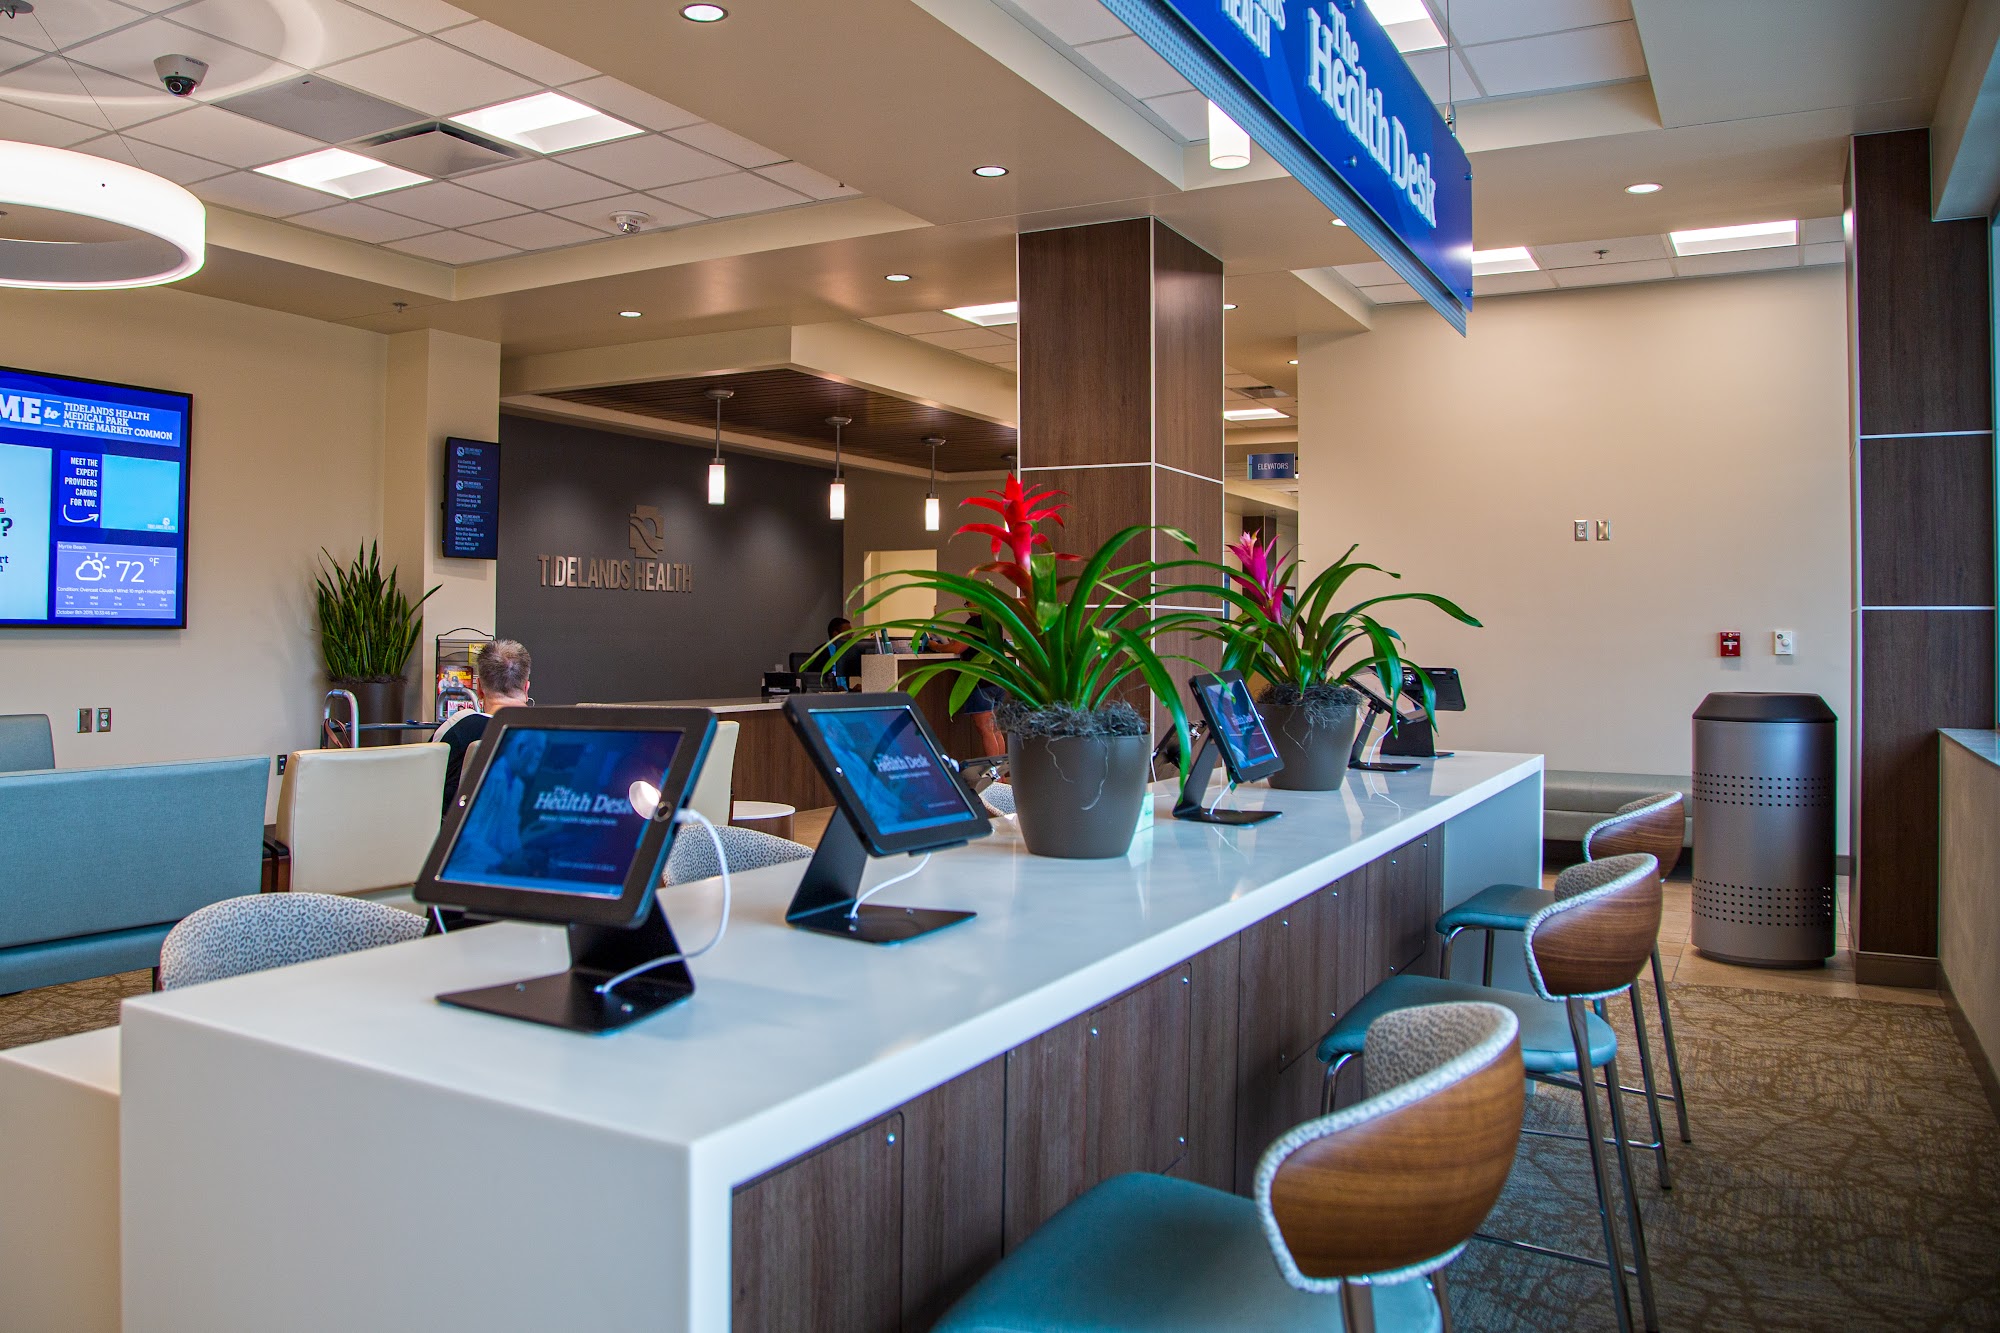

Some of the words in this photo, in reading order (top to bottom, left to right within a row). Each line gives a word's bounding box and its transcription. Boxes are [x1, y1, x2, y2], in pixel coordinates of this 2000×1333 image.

[1328, 2, 1360, 77] The
[1306, 7, 1391, 176] Health
[1391, 115, 1437, 229] Desk
[43, 406, 61, 420] to
[63, 402, 115, 417] TIDELANDS
[115, 409, 150, 422] HEALTH
[63, 411, 104, 424] MEDICAL
[105, 416, 129, 426] PARK
[63, 420, 76, 429] AT
[76, 421, 95, 431] THE
[95, 424, 133, 436] MARKET
[133, 428, 173, 441] COMMON
[70, 457, 86, 466] MEET
[87, 458, 98, 467] THE
[1257, 462, 1289, 471] ELEVATORS
[75, 467, 98, 477] EXPERT
[64, 477, 98, 487] PROVIDERS
[75, 487, 98, 498] CARING
[70, 498, 82, 507] FOR
[83, 499, 97, 508] YOU.
[116, 560, 145, 583] 72
[537, 553, 631, 590] TIDELANDS
[634, 560, 693, 593] HEALTH
[904, 754, 932, 769] Desk
[533, 791, 593, 812] Health
[592, 793, 633, 815] Desk
